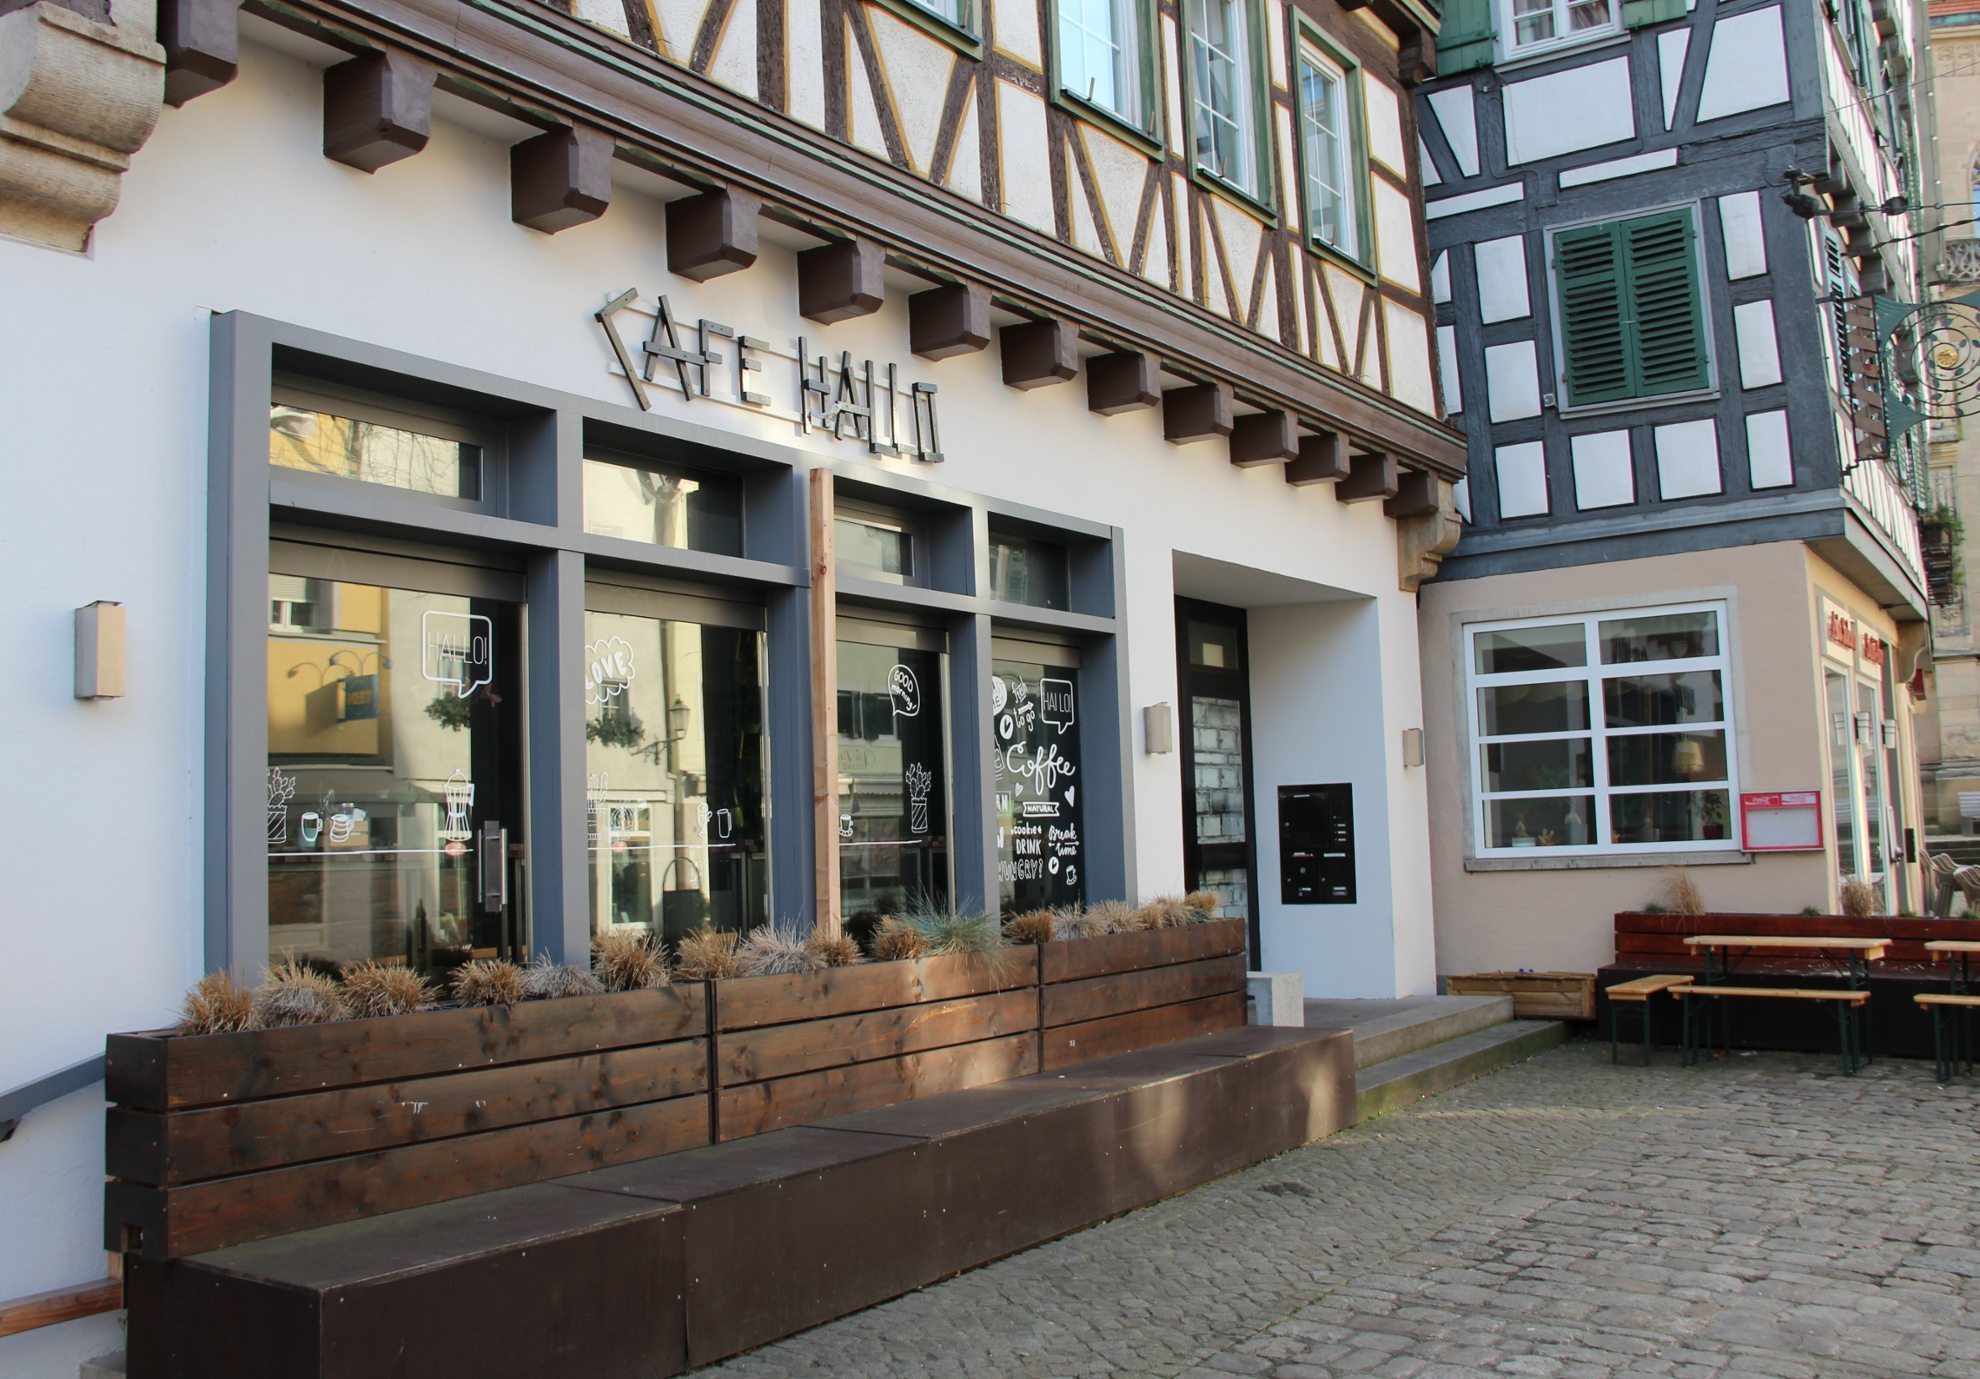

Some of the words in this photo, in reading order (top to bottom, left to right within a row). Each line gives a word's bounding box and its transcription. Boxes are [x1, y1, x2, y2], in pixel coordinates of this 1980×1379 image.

[595, 287, 771, 411] CAFE
[798, 336, 944, 463] HALLO
[894, 670, 913, 692] GOOD
[1013, 707, 1025, 728] to
[1026, 710, 1035, 732] go
[1006, 741, 1075, 796] Coffee
[1027, 804, 1054, 813] NATURAL
[1016, 838, 1041, 855] DRINK
